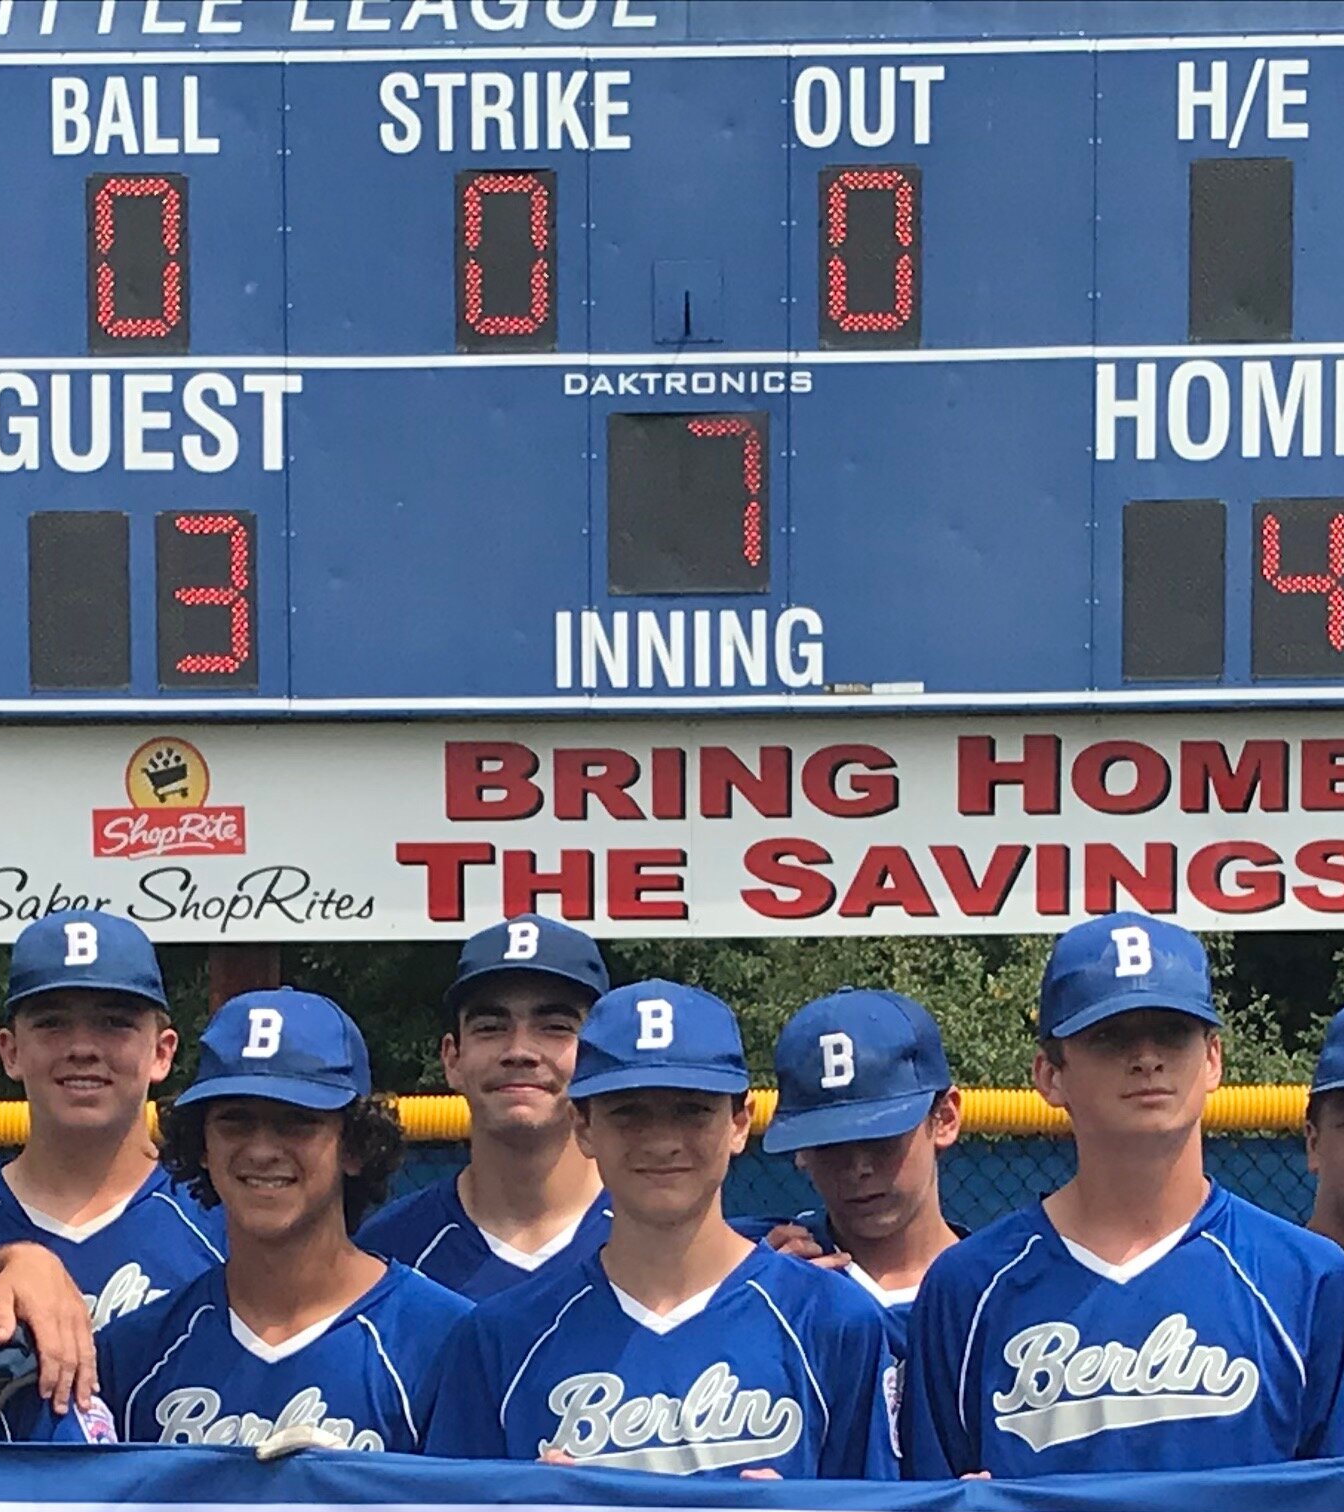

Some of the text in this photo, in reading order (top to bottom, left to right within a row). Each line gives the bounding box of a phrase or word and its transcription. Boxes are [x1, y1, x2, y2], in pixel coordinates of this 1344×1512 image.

[290, 1, 657, 32] LEAGUE
[51, 75, 220, 155] BALL
[379, 70, 631, 154] STRIKE
[793, 65, 945, 148] OUT
[1177, 58, 1309, 149] H/E
[95, 178, 181, 338] 0
[463, 173, 548, 335] 0
[827, 169, 914, 332] 0
[563, 371, 813, 395] DAKTRONICS
[687, 419, 761, 567] 7
[174, 514, 250, 674] 3
[554, 607, 825, 688] INNING
[444, 740, 900, 822] BRING
[101, 812, 238, 857] ShopRite
[127, 866, 375, 932] ShopRites
[396, 842, 688, 922] THE
[63, 920, 99, 966] B
[503, 919, 539, 960] B
[1110, 925, 1153, 978] B
[241, 1007, 284, 1059] B
[636, 998, 674, 1050] B
[819, 1031, 855, 1088] B
[994, 1312, 1260, 1428] Berlin
[538, 1360, 804, 1466] Berlin
